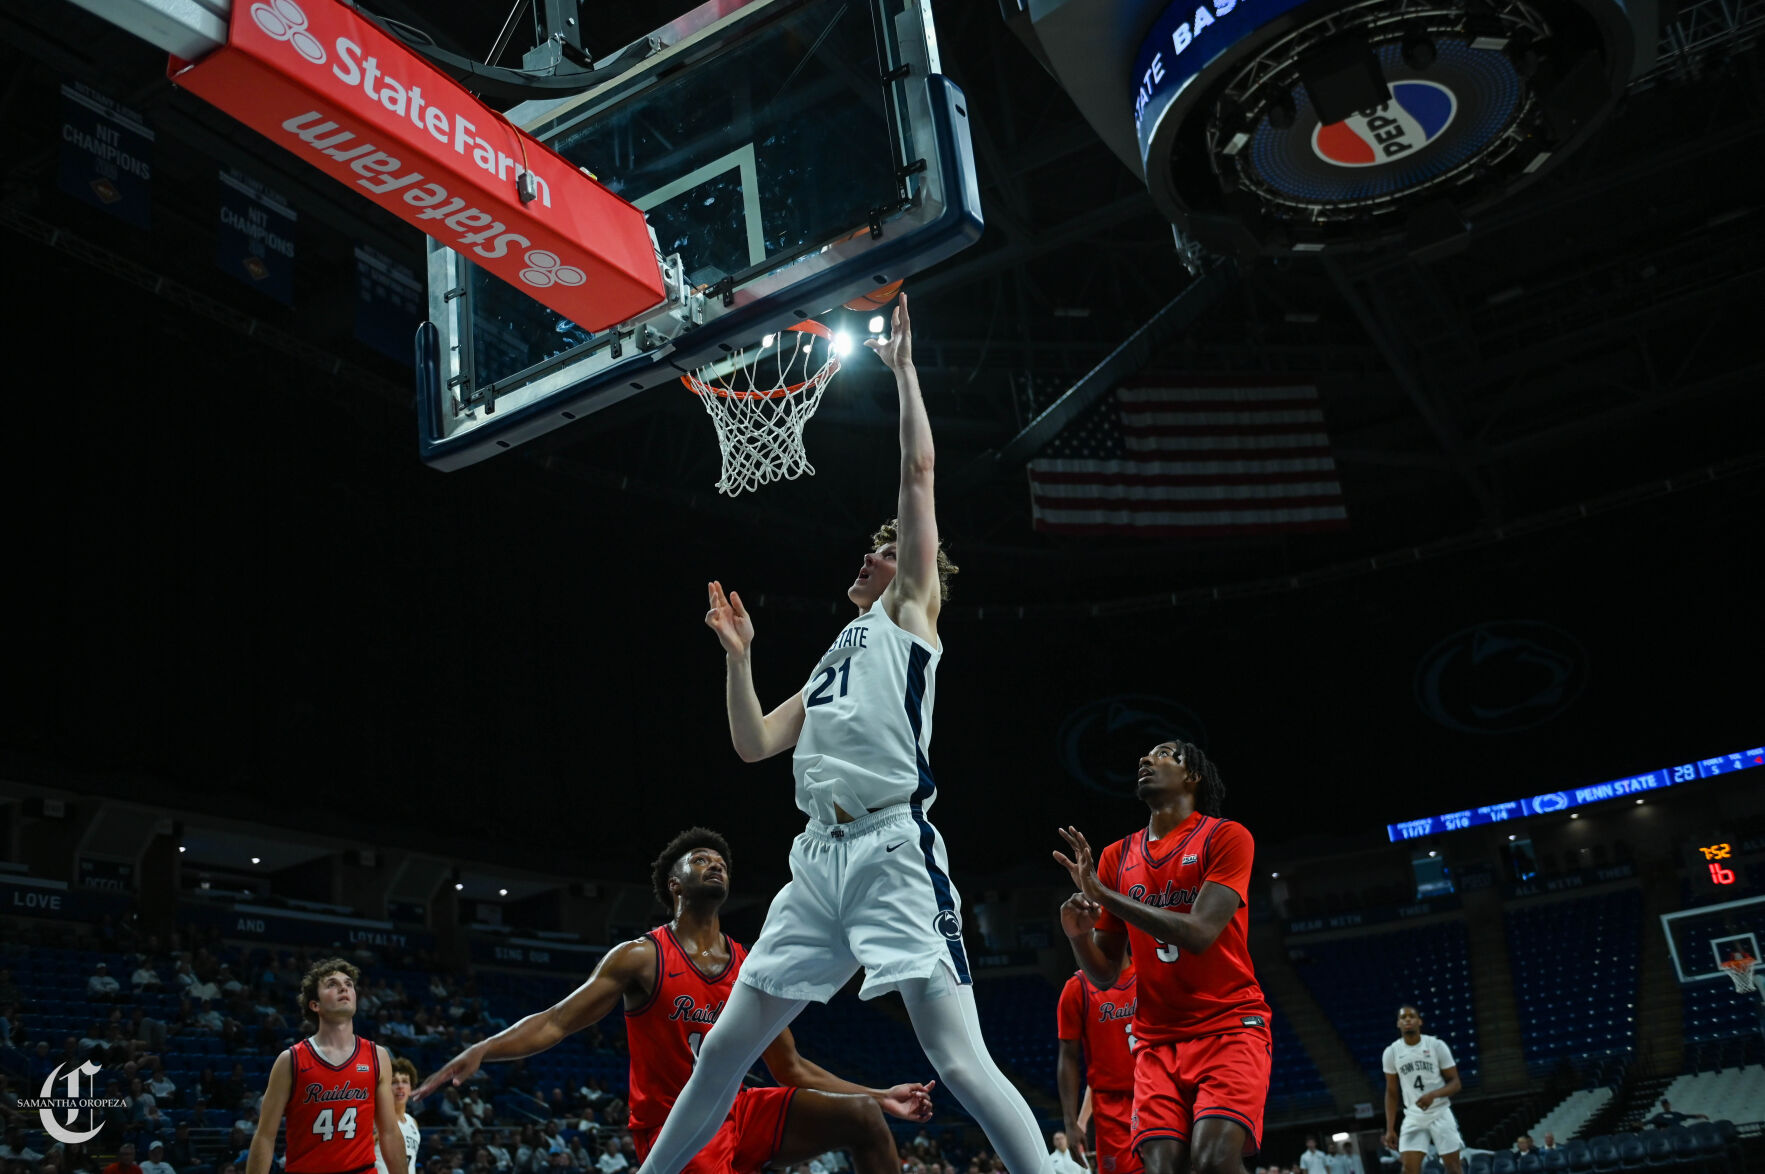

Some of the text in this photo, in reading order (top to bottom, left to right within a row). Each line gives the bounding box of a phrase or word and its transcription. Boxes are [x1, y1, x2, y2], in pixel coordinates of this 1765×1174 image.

[1172, 0, 1238, 55] BAS
[96, 123, 120, 147] NIT
[332, 37, 551, 208] StateFarm
[1359, 102, 1412, 157] PEPS
[62, 123, 151, 180] CHAMPIONS
[282, 111, 531, 258] StateFarm
[248, 205, 268, 228] NIT
[220, 205, 295, 258] CHAMPIONS
[807, 656, 851, 708] 21
[1575, 783, 1614, 804] PENN
[1613, 774, 1657, 795] STATE
[1673, 763, 1695, 783] 28
[1708, 862, 1736, 885] 16
[13, 890, 62, 910] LOVE
[1128, 880, 1200, 908] Raiders
[236, 917, 266, 933] AND
[350, 929, 408, 948] LOYALTY
[669, 995, 725, 1025] Raid
[1098, 996, 1138, 1023] Raid
[1415, 1060, 1435, 1073] STATE
[304, 1081, 369, 1104] Raiders
[1413, 1075, 1425, 1091] 4
[312, 1107, 358, 1142] 44
